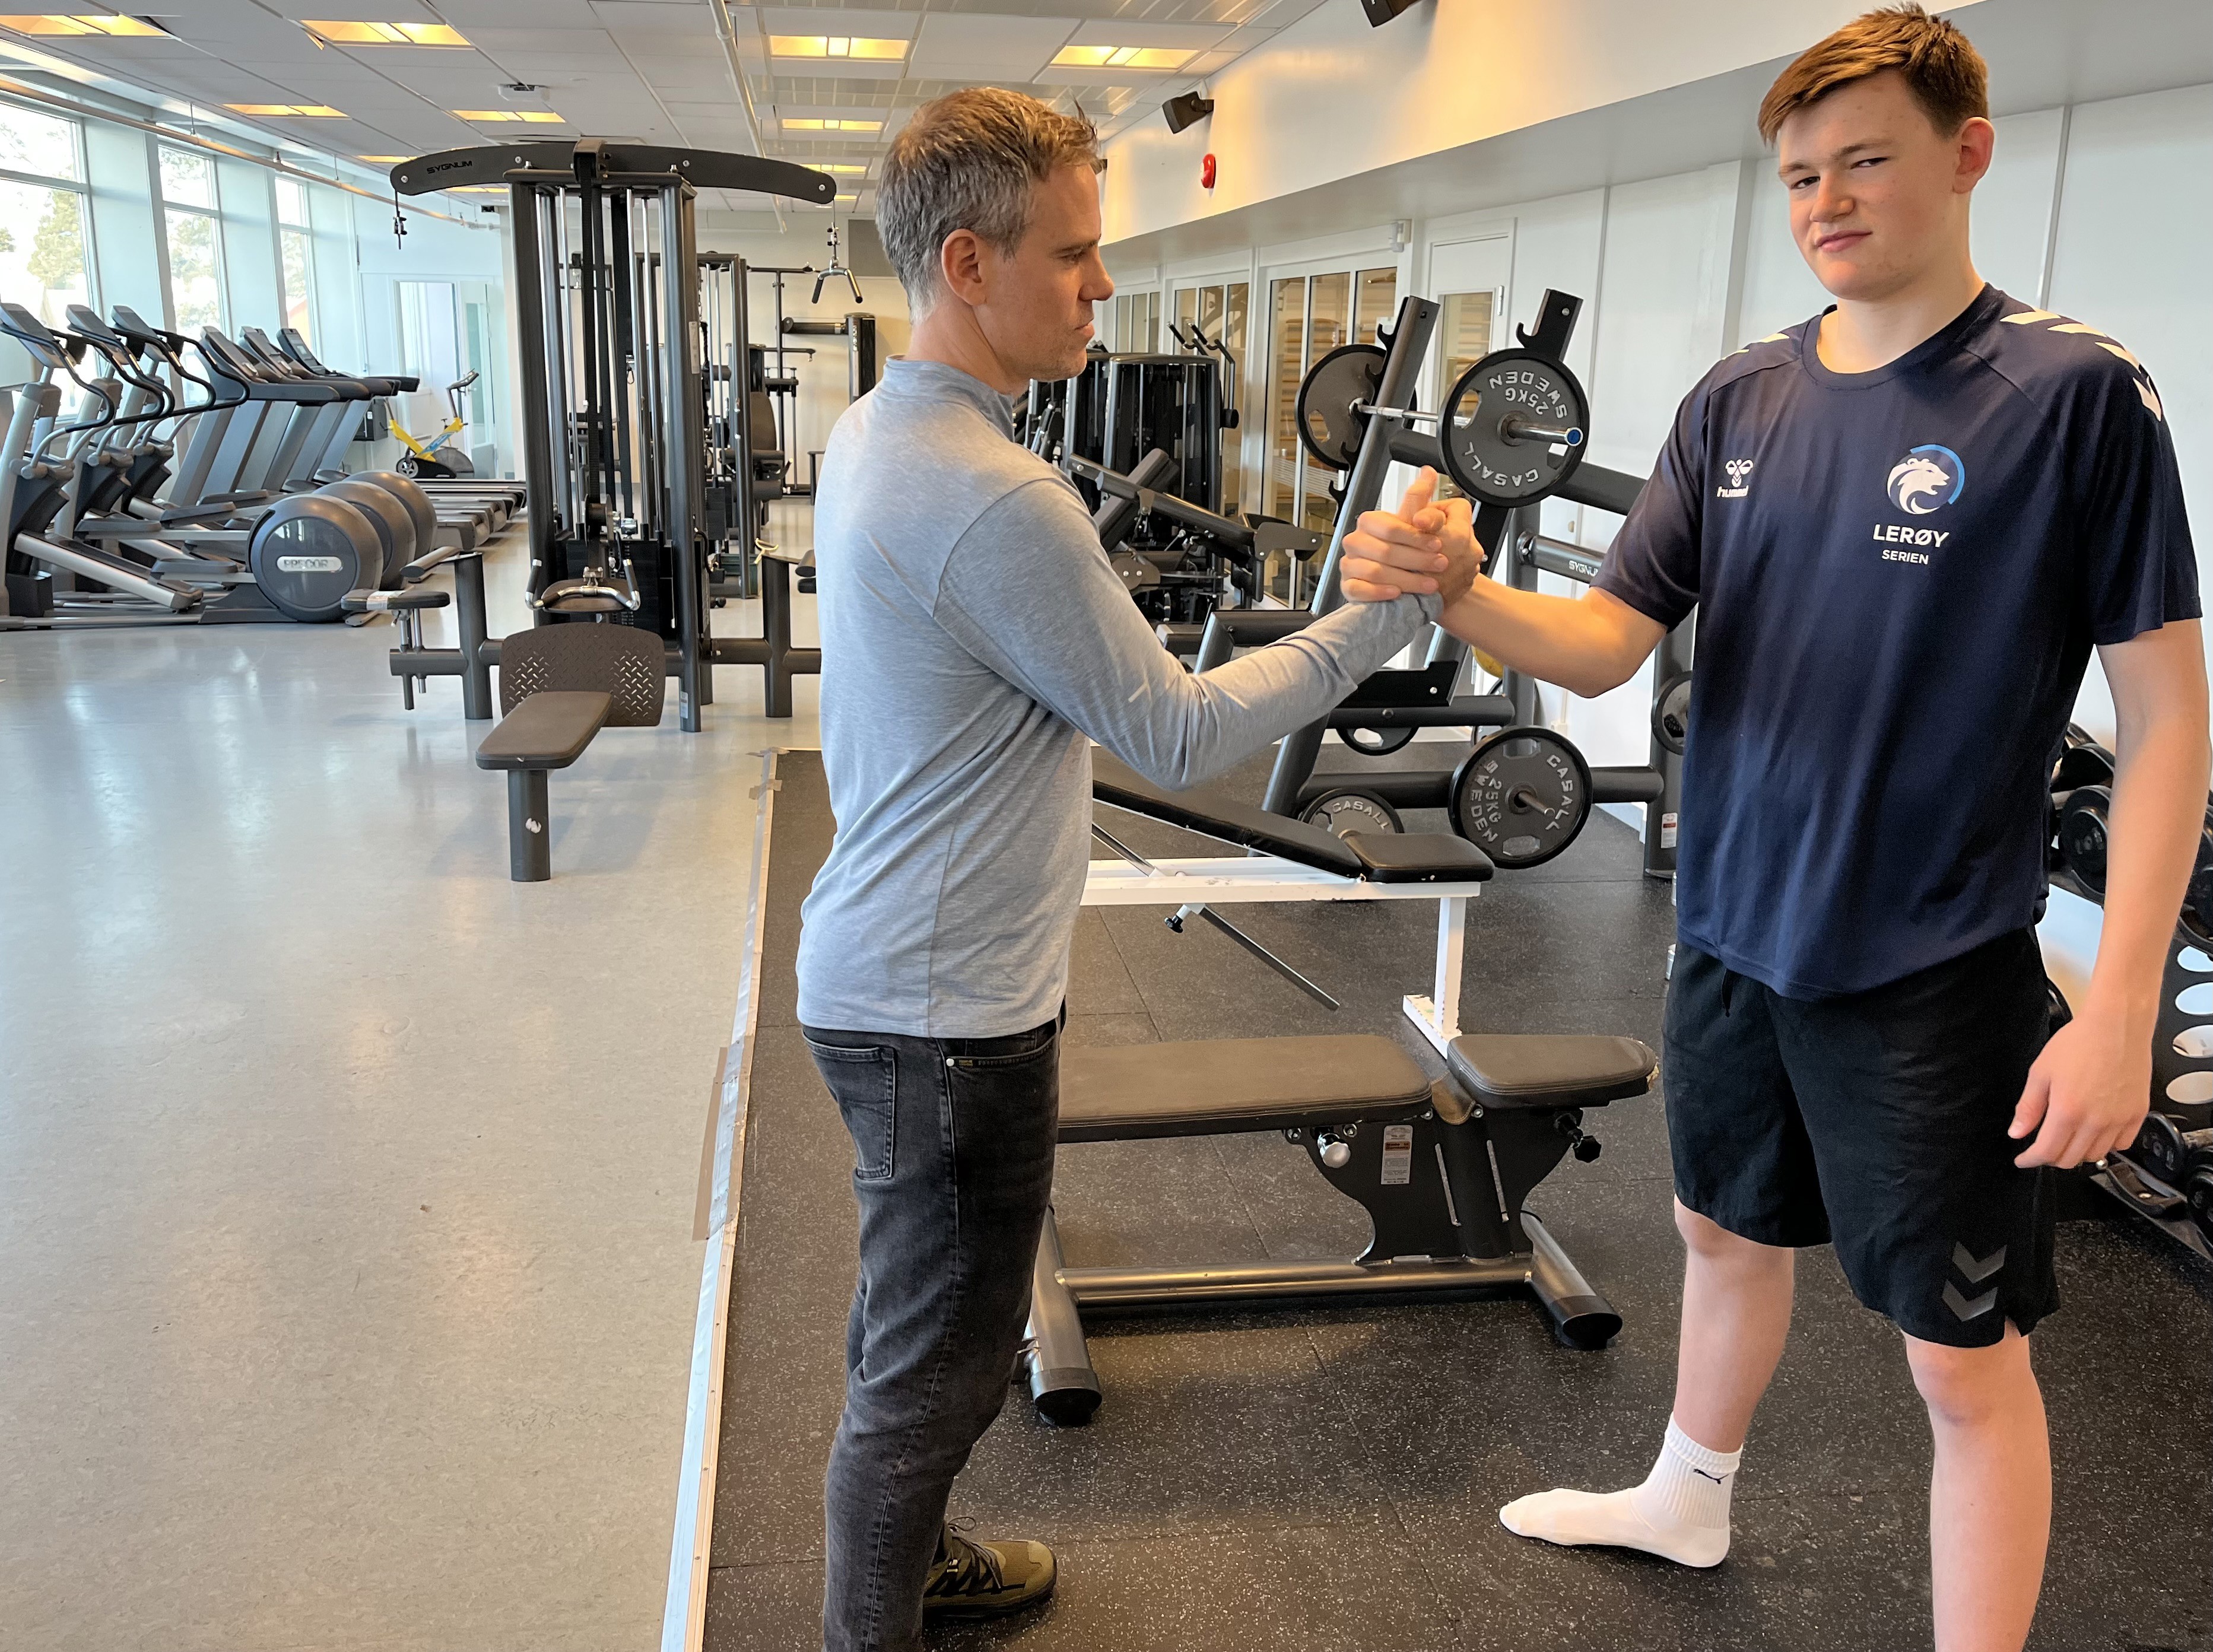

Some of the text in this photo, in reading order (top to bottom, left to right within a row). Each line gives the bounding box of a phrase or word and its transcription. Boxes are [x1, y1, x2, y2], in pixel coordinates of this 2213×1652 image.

[427, 160, 472, 174] SYGNUM
[1488, 371, 1567, 418] SWEDEN
[1505, 387, 1549, 415] 25KG
[1464, 441, 1539, 487] CASALL
[1873, 524, 1950, 548] LERØY
[1569, 560, 1599, 577] SYGNU
[1881, 549, 1929, 565] SERIEN
[1471, 760, 1498, 843] SWEDEN
[1485, 777, 1502, 823] 25KG
[1545, 754, 1573, 830] CASALL
[1332, 800, 1389, 830] CASALL
